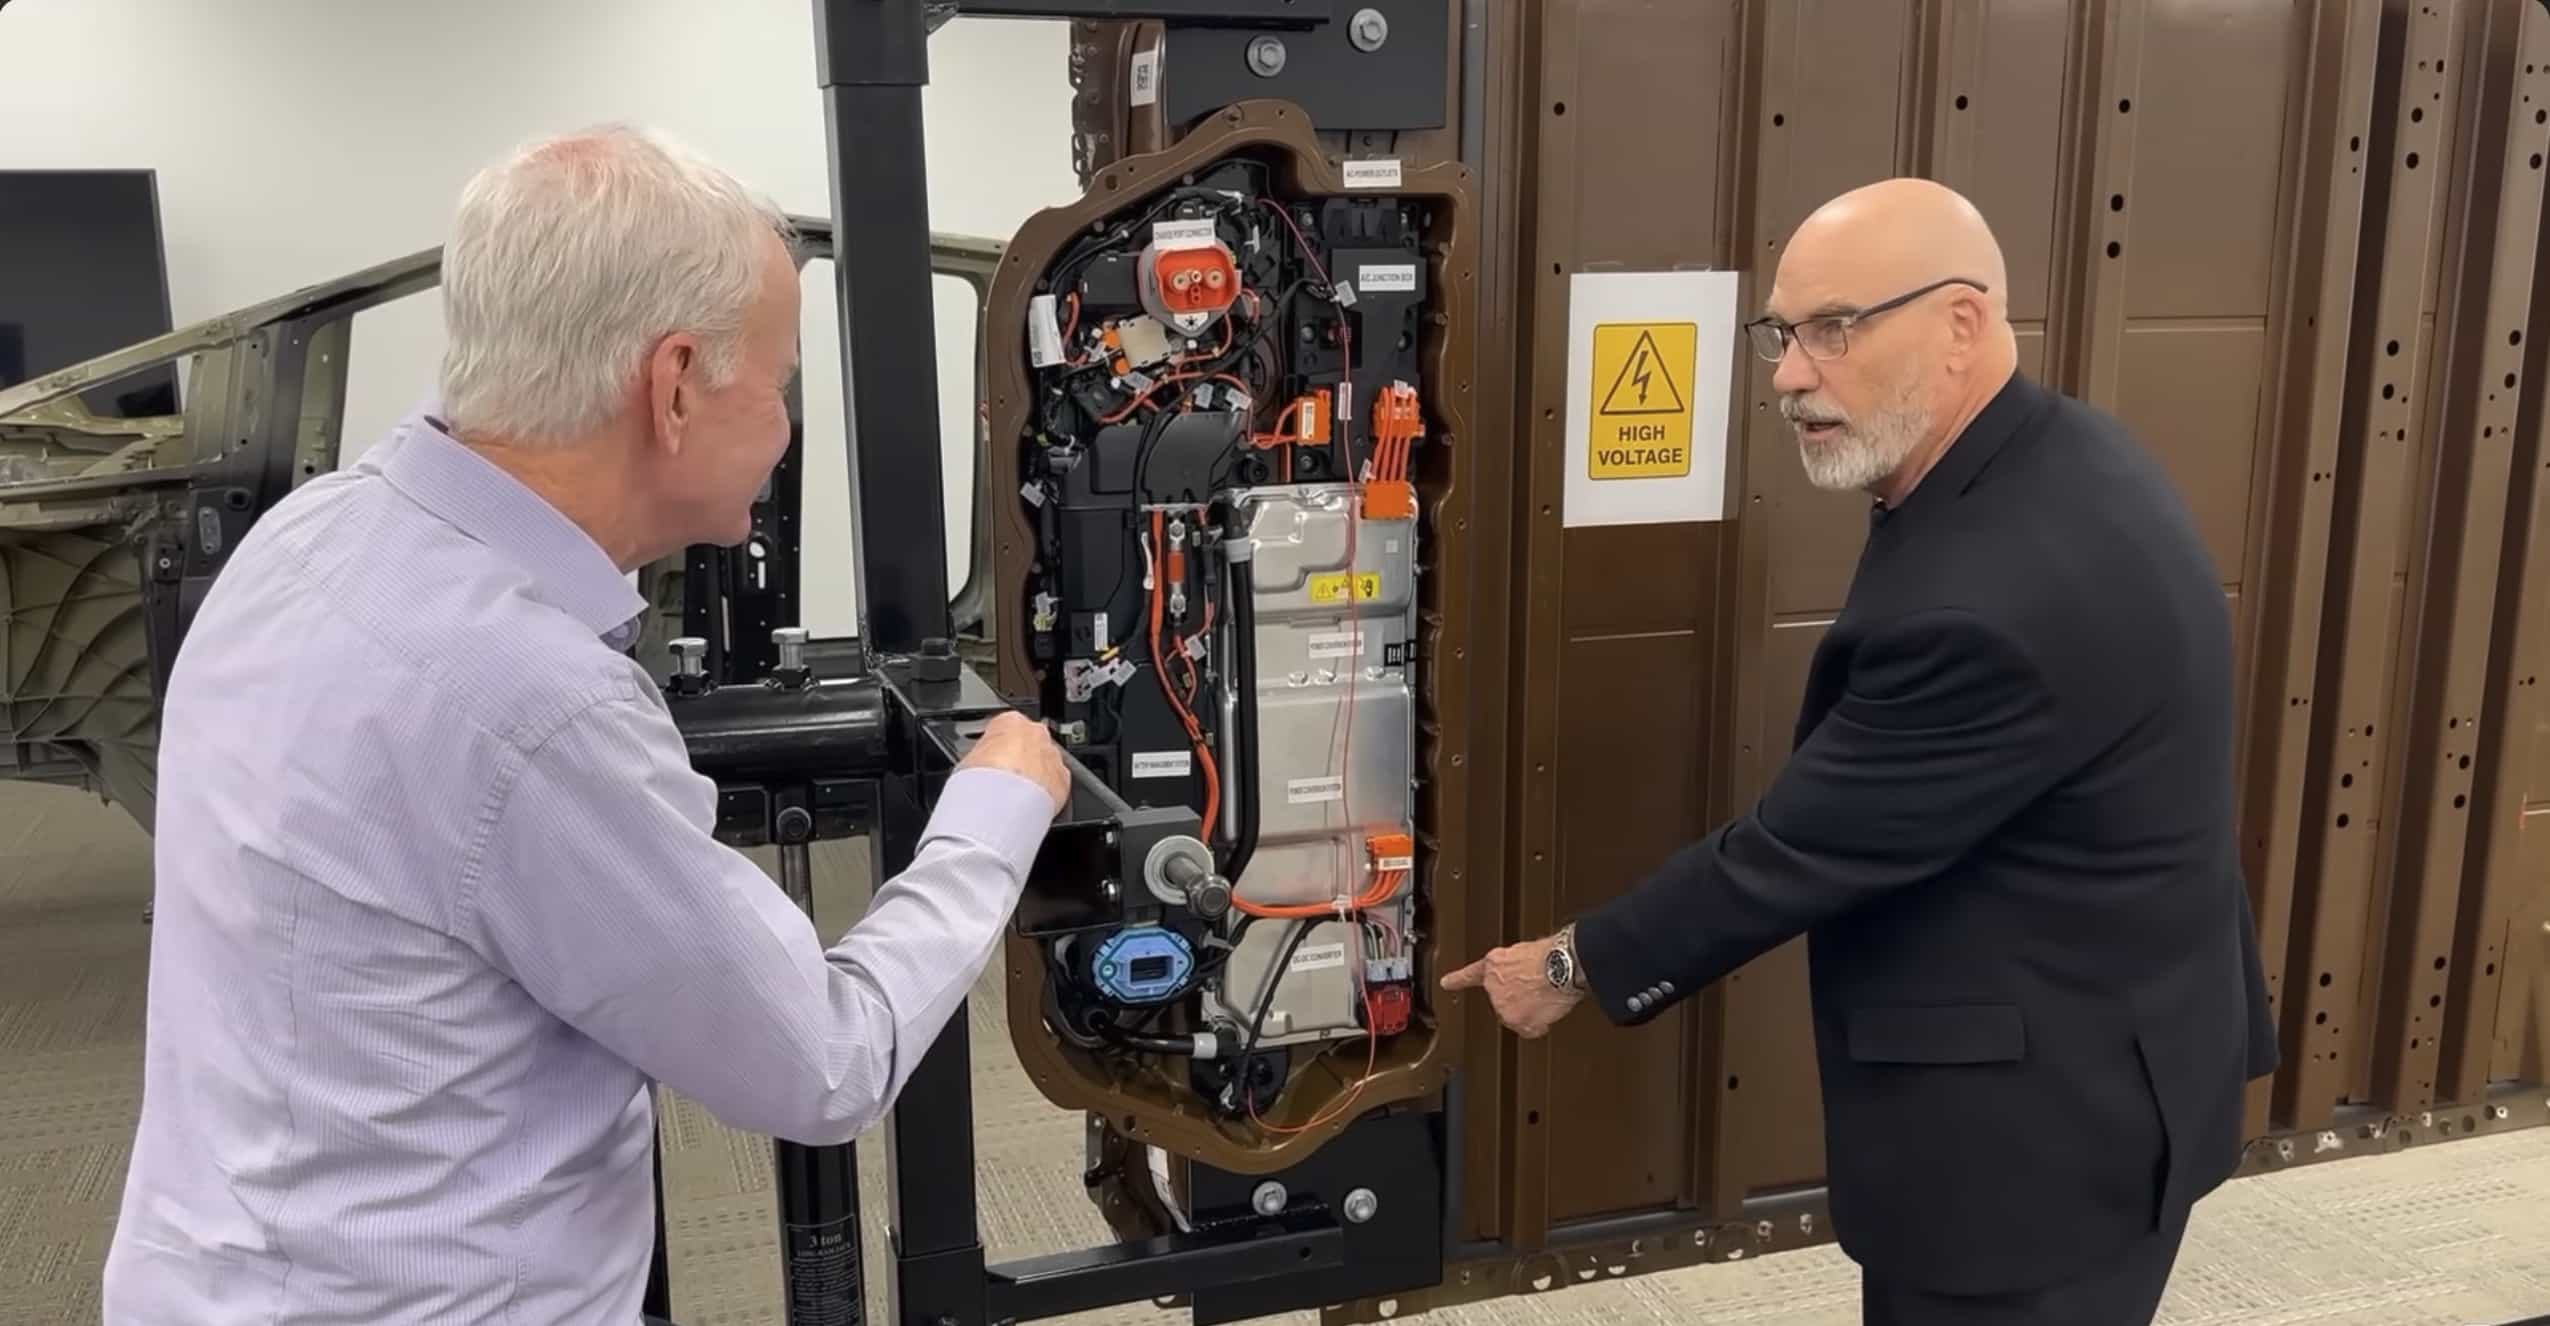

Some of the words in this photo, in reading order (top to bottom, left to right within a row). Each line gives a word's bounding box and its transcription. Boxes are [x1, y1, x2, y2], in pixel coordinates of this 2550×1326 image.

[1619, 425, 1665, 441] HIGH
[1598, 448, 1683, 466] VOLTAGE
[809, 1235, 817, 1248] 3
[821, 1233, 841, 1247] ton
